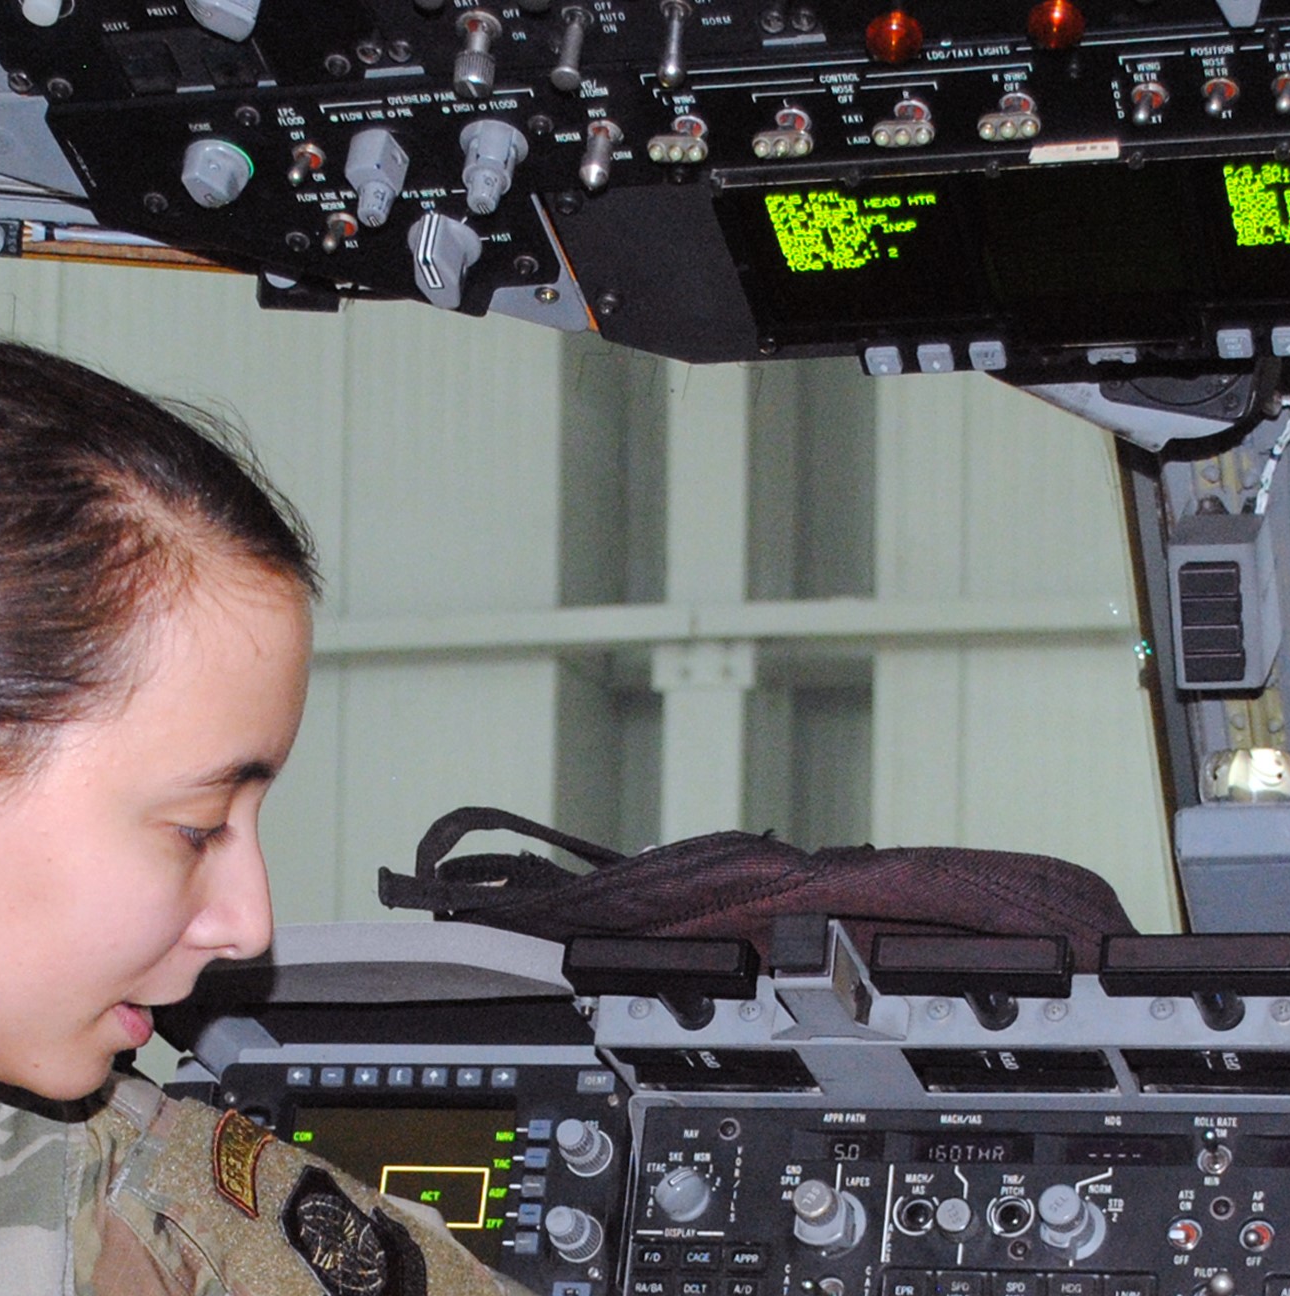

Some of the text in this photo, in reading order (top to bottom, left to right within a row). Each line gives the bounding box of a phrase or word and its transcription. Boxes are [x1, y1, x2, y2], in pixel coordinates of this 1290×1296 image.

[599, 13, 626, 23] AUTO
[702, 16, 732, 26] NORM
[926, 46, 1011, 60] LDG/TAXI LIGHTS
[1190, 45, 1234, 57] POSITION
[1137, 62, 1161, 71] WING
[1202, 57, 1226, 67] NOSE
[819, 73, 860, 84] CONTROL
[1133, 73, 1157, 82] RETR
[831, 85, 855, 94] NOSE
[490, 100, 517, 110] FLOOD
[555, 133, 581, 142] NORM
[863, 194, 936, 208] HEAD HTR
[491, 233, 511, 242] FAST
[823, 1113, 866, 1123] APPR PATH
[940, 1114, 982, 1124] MACH/IAS
[1194, 1117, 1237, 1127] ROLL RATE
[496, 1131, 514, 1143] NAV
[494, 1159, 512, 1170] TAC
[846, 1177, 870, 1187] LAPES
[1001, 1186, 1025, 1196] PITCH
[1088, 1184, 1112, 1194] NORM
[1178, 1190, 1195, 1200] ATS
[486, 1218, 504, 1230] IFF
[664, 1229, 696, 1238] DISPLAY
[644, 1253, 661, 1263] F/D
[687, 1252, 710, 1263] CAGE
[733, 1284, 752, 1295] A/D
[895, 1286, 914, 1296] EPR
[1006, 1283, 1025, 1293] SPD
